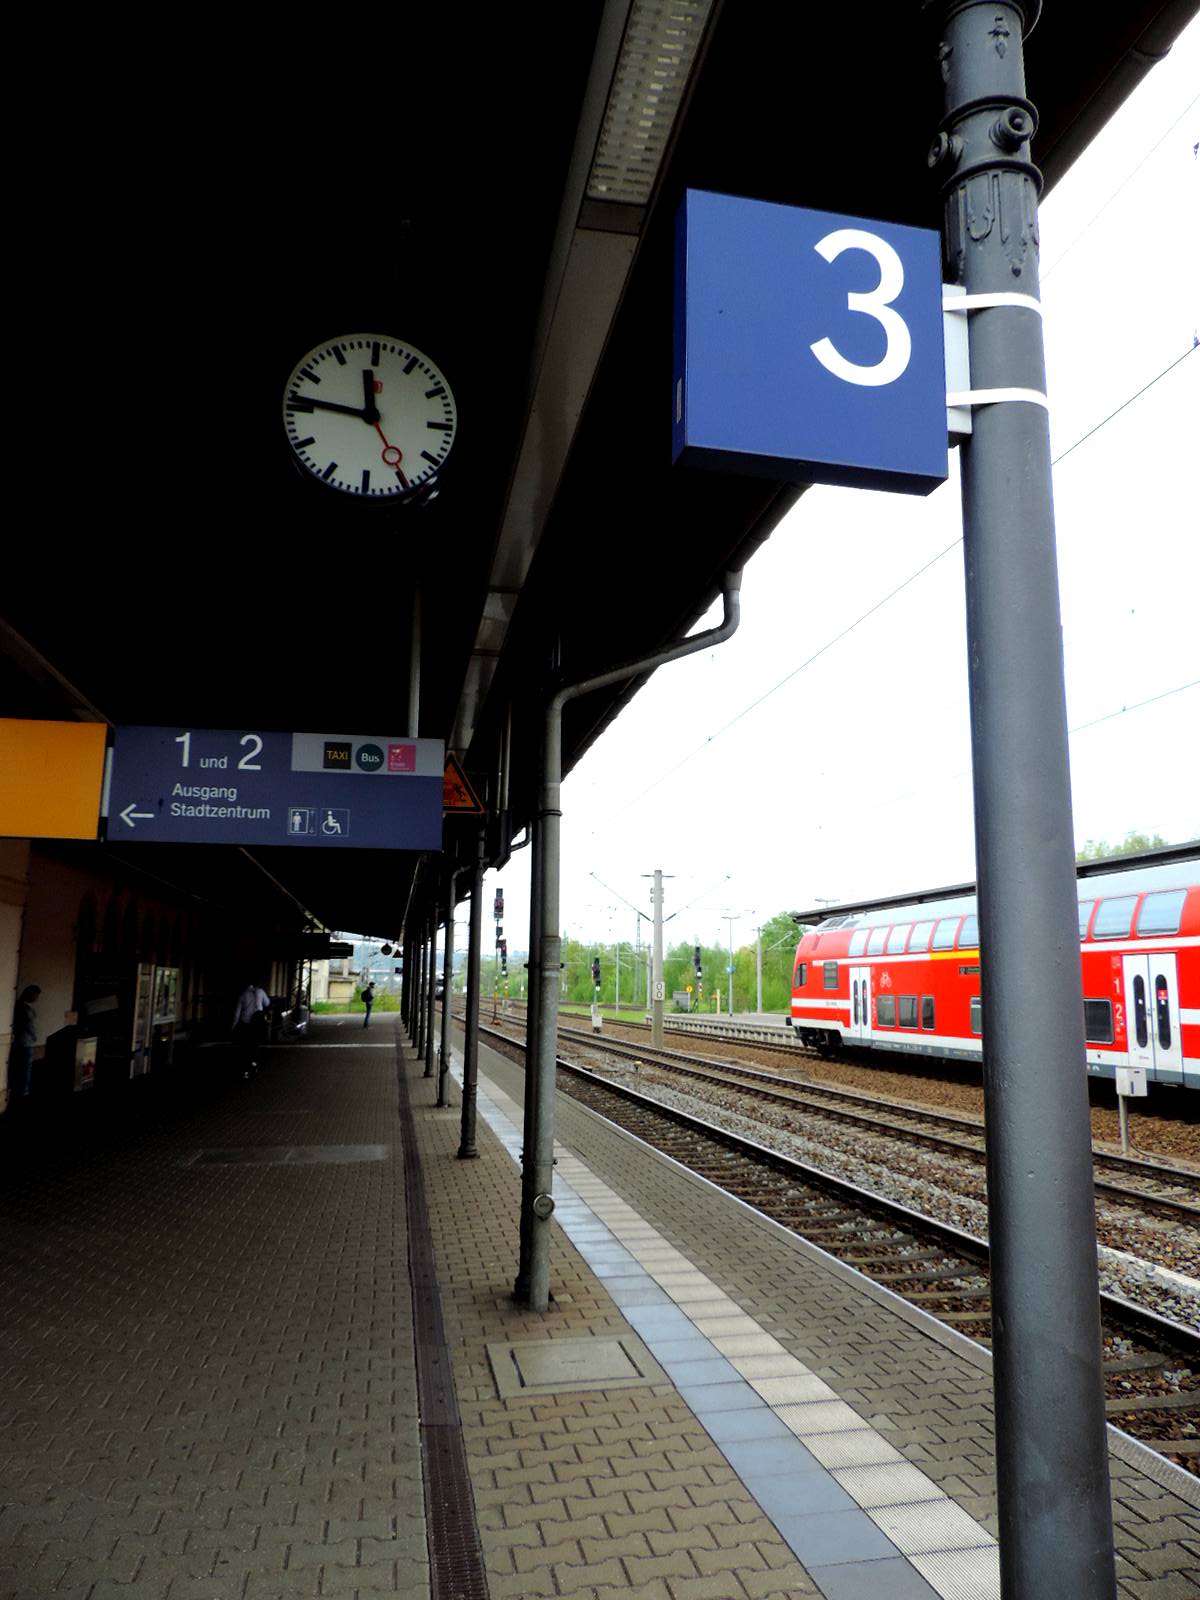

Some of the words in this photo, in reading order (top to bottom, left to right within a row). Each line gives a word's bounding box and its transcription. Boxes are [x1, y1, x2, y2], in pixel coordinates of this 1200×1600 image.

[809, 228, 912, 386] 3
[175, 732, 191, 767] 1
[200, 755, 228, 769] und
[237, 735, 263, 770] 2
[327, 750, 349, 760] TAXI
[361, 752, 379, 762] Bus
[172, 783, 237, 801] Ausgang
[170, 803, 270, 819] Stadtzentrum
[1113, 978, 1120, 994] 1
[1115, 1004, 1123, 1020] 2
